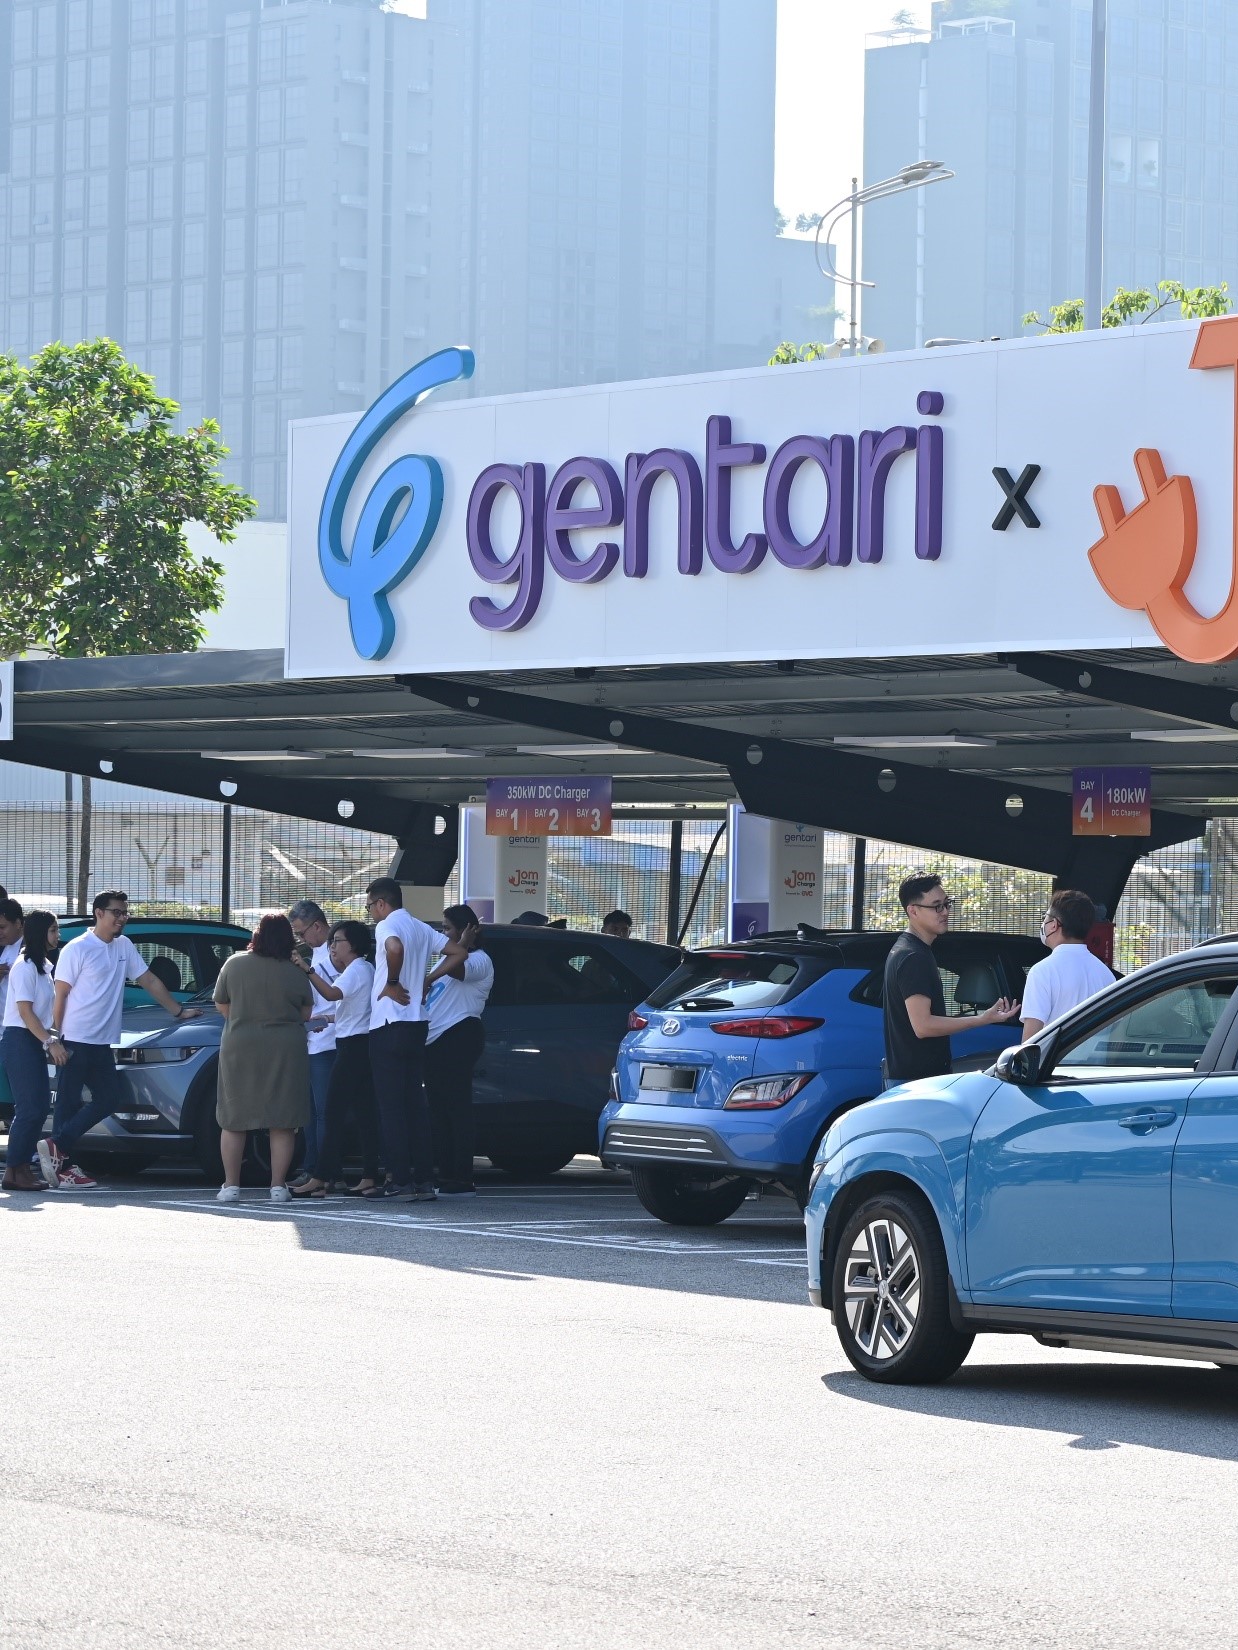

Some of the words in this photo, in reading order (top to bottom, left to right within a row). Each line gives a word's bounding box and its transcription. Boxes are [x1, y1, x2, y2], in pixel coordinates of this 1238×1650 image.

[466, 391, 944, 632] gentari
[507, 785, 536, 800] 350kW
[538, 785, 552, 799] DC
[554, 785, 591, 802] Charger
[1080, 781, 1095, 790] BAY
[1106, 787, 1147, 804] 180kW
[1080, 797, 1094, 823] 4
[1111, 809, 1120, 817] DC
[1120, 809, 1141, 818] Charger
[495, 808, 508, 818] BAY
[510, 808, 519, 831] 1
[534, 808, 547, 818] BAY
[548, 808, 559, 831] 2
[576, 808, 589, 818] BAY
[590, 808, 601, 832] 3
[784, 833, 817, 844] gentari
[784, 870, 816, 888] Jom
